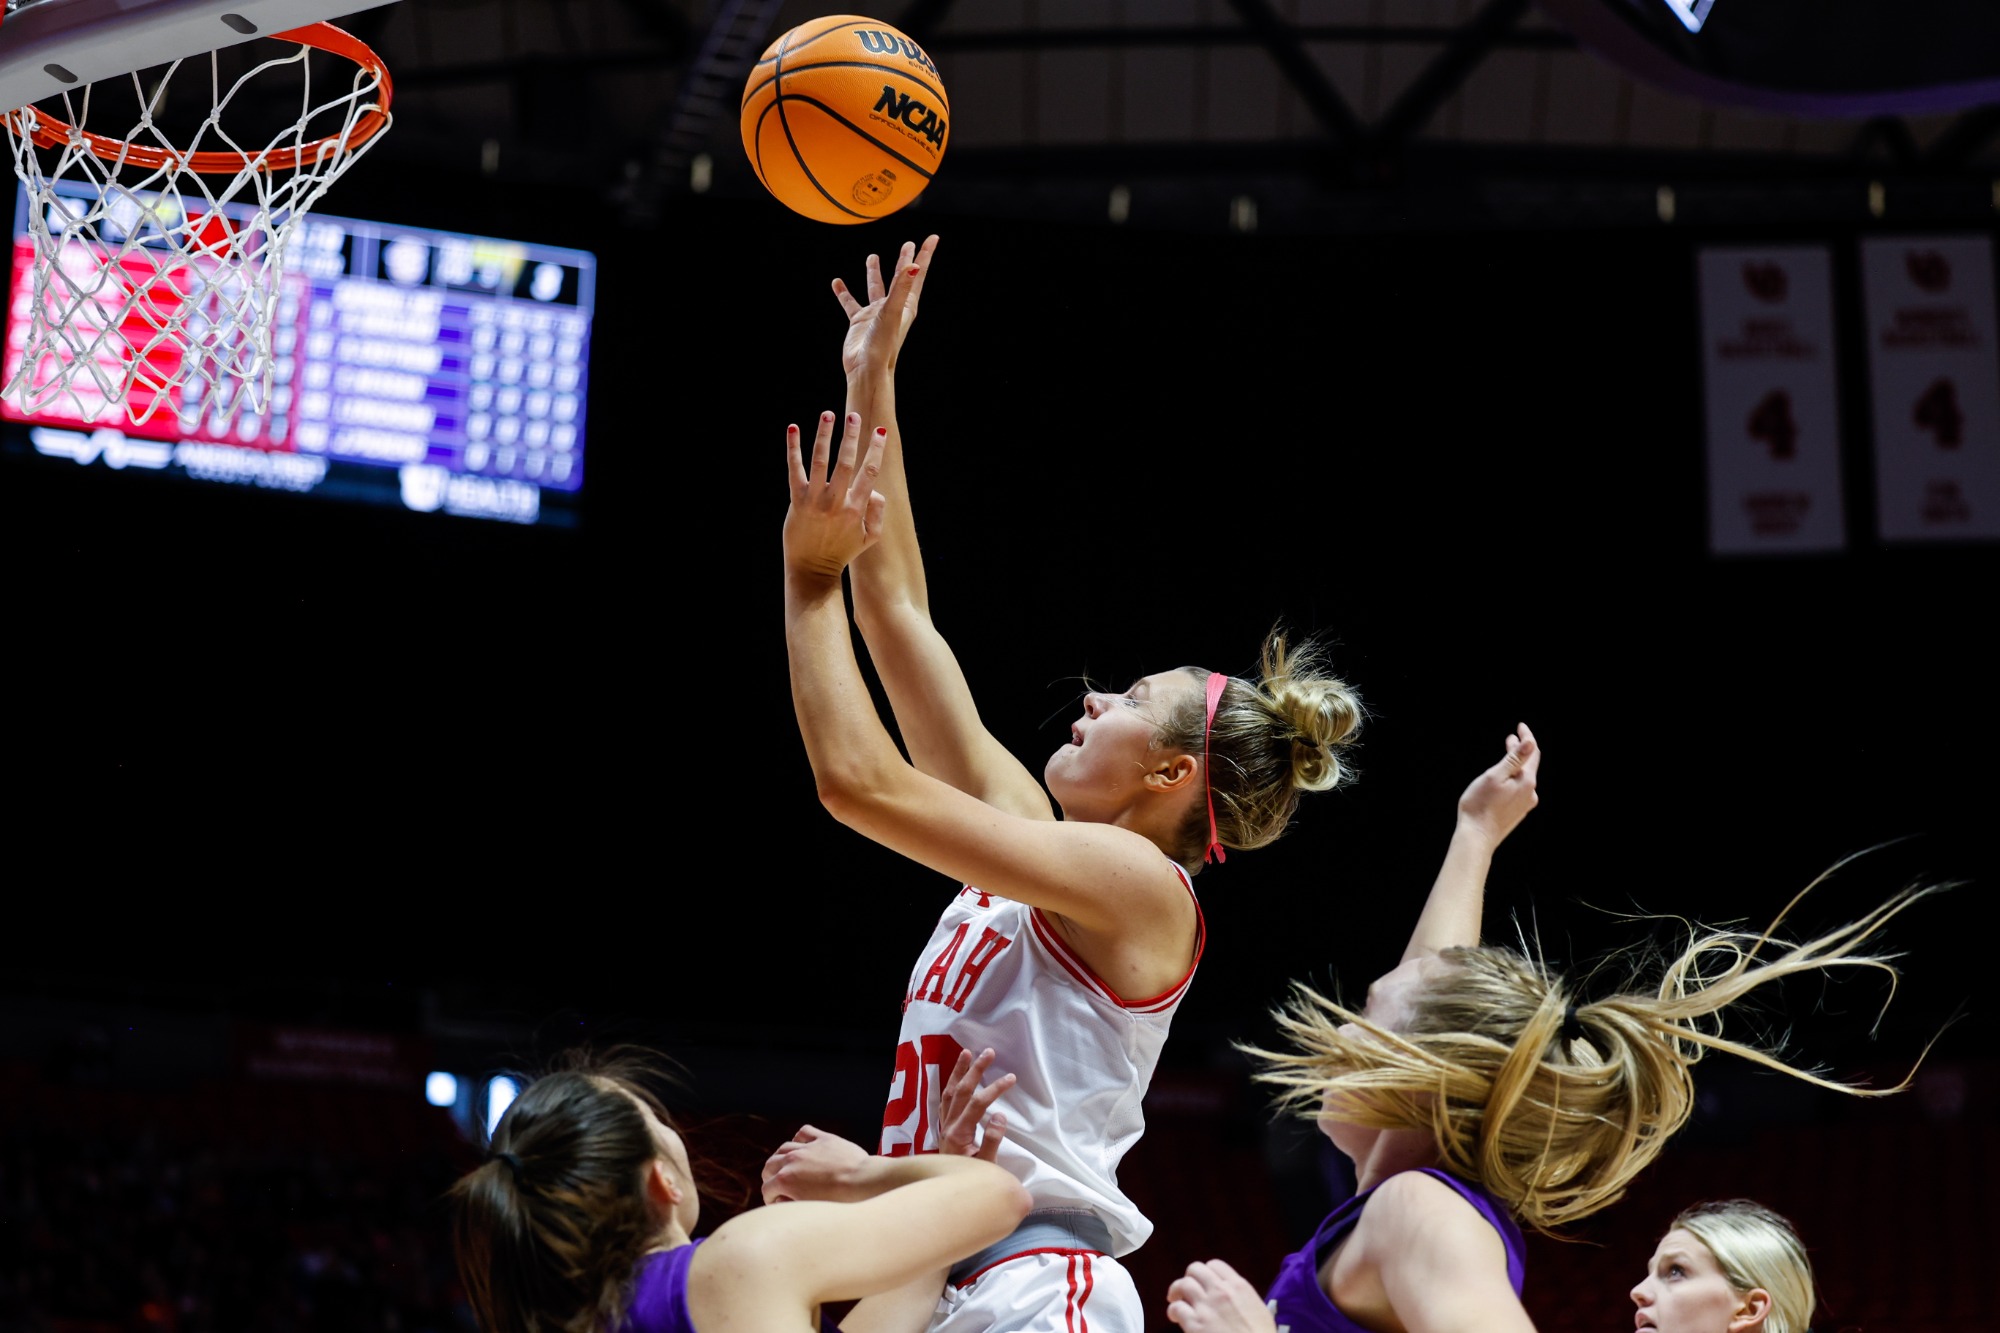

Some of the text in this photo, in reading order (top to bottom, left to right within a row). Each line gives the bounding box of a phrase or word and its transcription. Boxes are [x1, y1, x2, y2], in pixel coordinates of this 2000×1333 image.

[869, 113, 906, 136] OFFICIAL
[906, 132, 928, 149] GAME
[873, 85, 947, 152] NCAA
[1746, 387, 1797, 461] 4
[1912, 376, 1964, 452] 4
[901, 922, 1012, 1014] AH
[877, 1033, 969, 1158] 20
